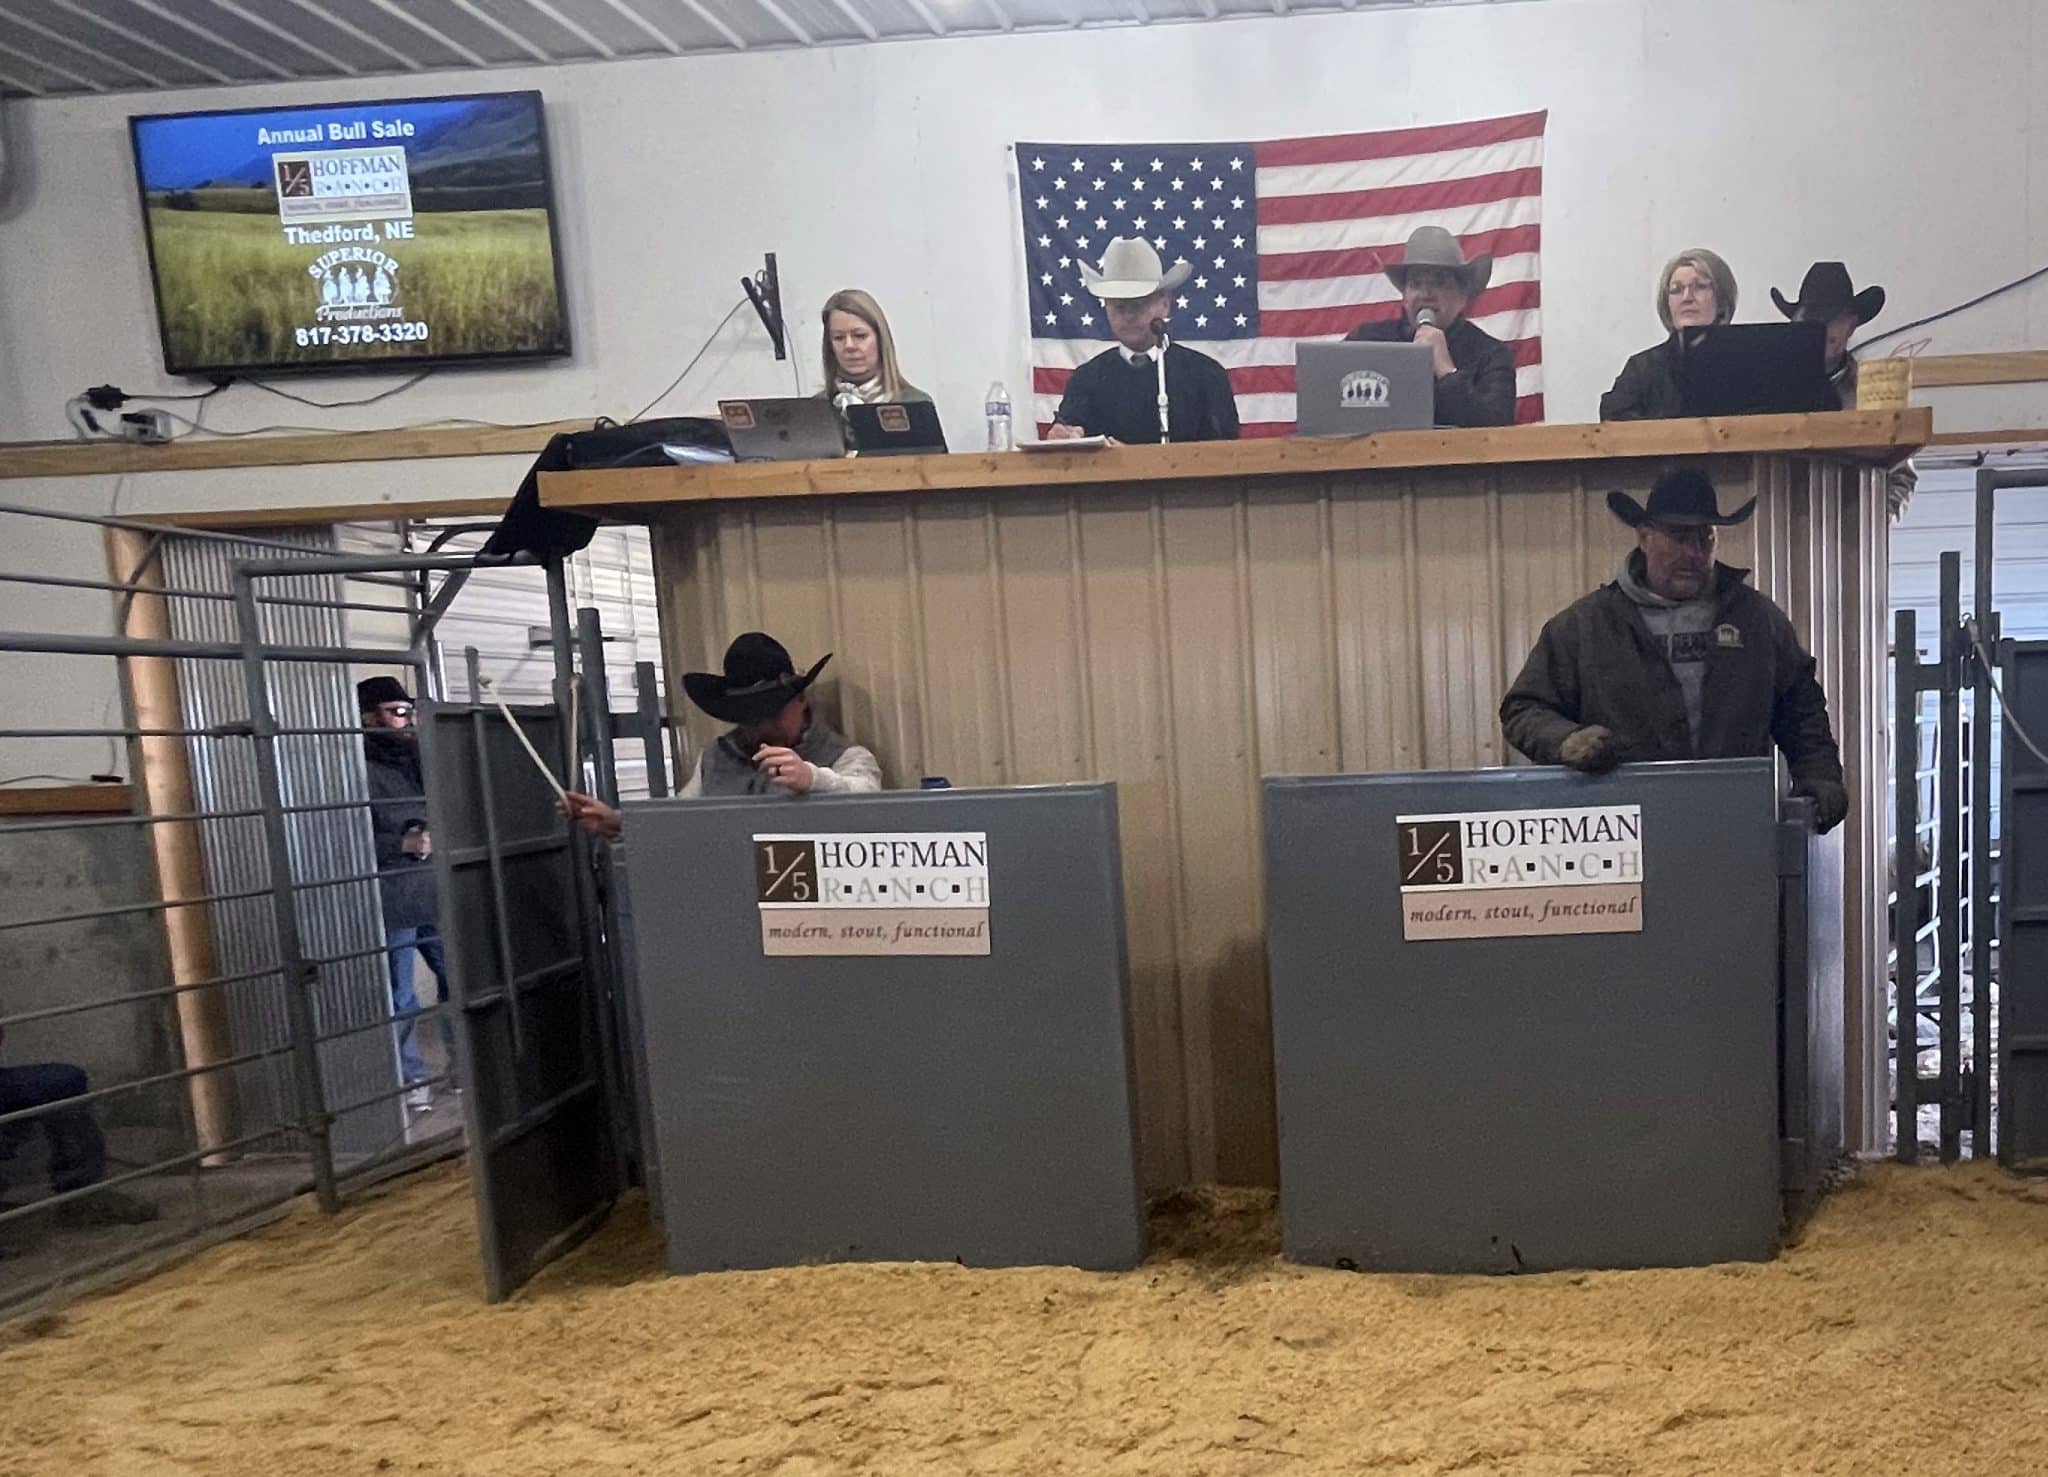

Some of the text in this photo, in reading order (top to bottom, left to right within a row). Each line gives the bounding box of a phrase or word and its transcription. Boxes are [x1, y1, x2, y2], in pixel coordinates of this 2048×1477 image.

[257, 119, 415, 145] Annual Bull Sale
[313, 156, 401, 177] HOFFMAN
[284, 221, 415, 244] Thedford, NE
[308, 247, 399, 279] SUPERIOR
[295, 321, 429, 347] 817-378-3320
[1465, 813, 1640, 848] HOFFMAN
[819, 841, 986, 868] HOFFMAN
[1410, 896, 1638, 923] modern, stout, functional
[768, 921, 984, 943] modern, stout, functional
